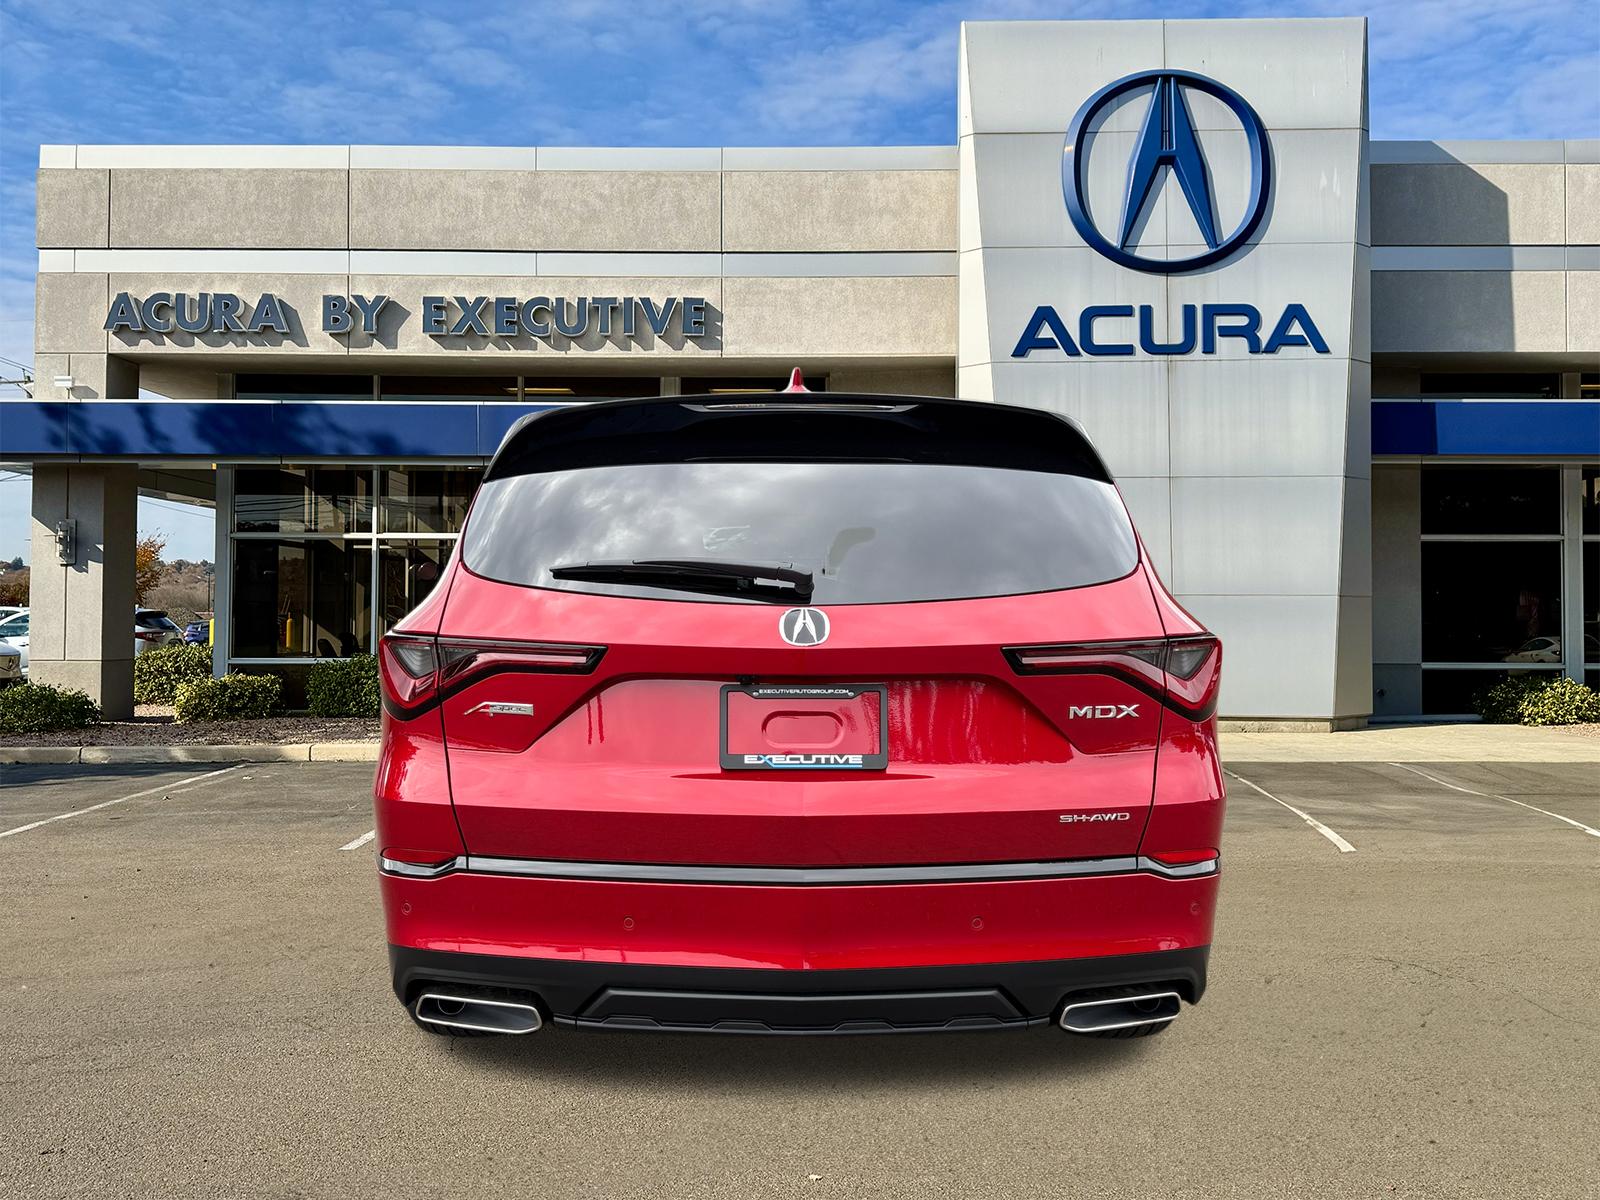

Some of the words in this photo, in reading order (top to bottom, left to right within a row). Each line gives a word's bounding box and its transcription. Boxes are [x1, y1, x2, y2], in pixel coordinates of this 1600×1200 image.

[103, 292, 290, 333] ACURA
[322, 294, 390, 334] BY
[422, 295, 706, 337] EXECUTIVE
[1011, 303, 1332, 357] ACURA
[1068, 704, 1140, 719] MDX
[744, 754, 863, 767] EXECUTIVE
[1059, 812, 1131, 823] SH-AWD
